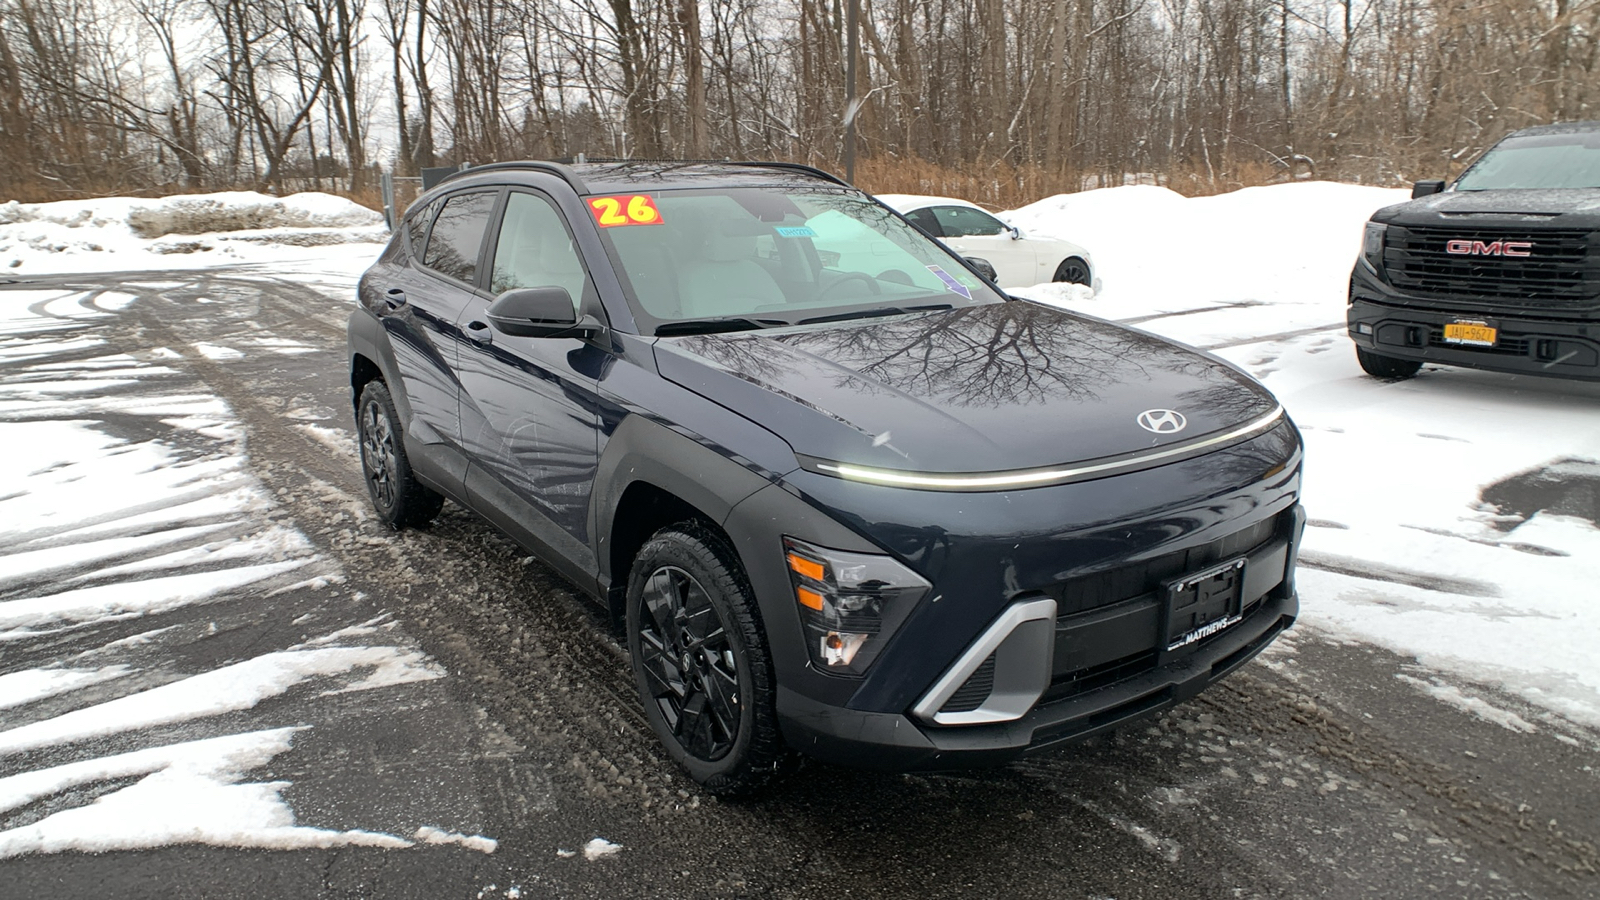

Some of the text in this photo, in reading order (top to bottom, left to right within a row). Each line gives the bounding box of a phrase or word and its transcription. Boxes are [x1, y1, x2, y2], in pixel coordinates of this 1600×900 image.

[592, 195, 658, 226] 26
[1446, 239, 1532, 257] GMC
[1185, 617, 1228, 645] MATTHEWS
